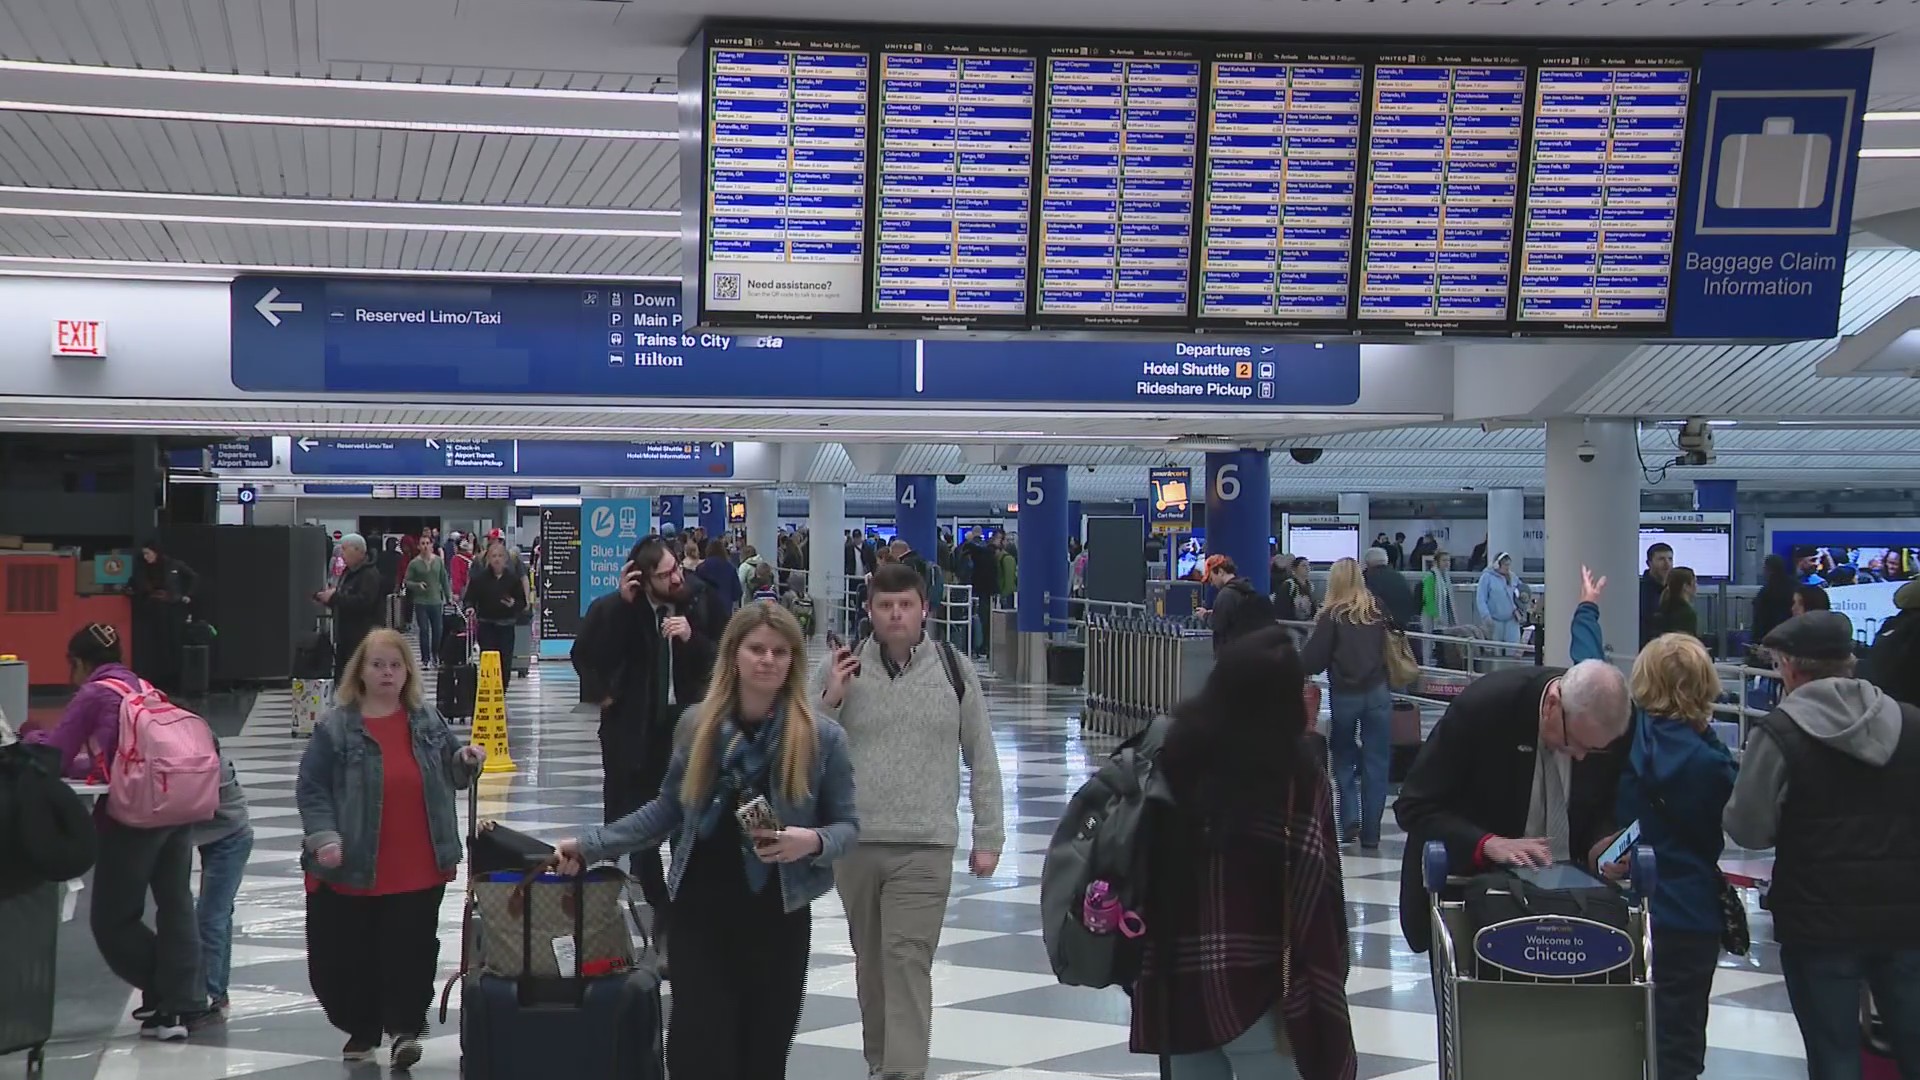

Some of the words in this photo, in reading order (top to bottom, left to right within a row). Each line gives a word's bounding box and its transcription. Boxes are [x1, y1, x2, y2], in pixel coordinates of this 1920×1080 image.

[1685, 252, 1773, 275] Baggage
[1780, 252, 1836, 271] Claim
[747, 280, 774, 289] Need
[775, 280, 832, 290] assistance?
[1703, 277, 1813, 295] Information
[634, 293, 675, 306] Down
[355, 309, 425, 323] Reserved
[430, 310, 501, 325] Limo/Taxi
[634, 314, 670, 326] Main
[57, 320, 99, 347] EXIT
[634, 333, 677, 347] Trains
[681, 334, 695, 347] to
[700, 335, 730, 350] City
[756, 336, 783, 348] cta
[1176, 342, 1251, 358] Departures
[634, 352, 683, 366] Hilton
[1144, 362, 1178, 376] Hotel
[1182, 362, 1230, 376] Shuttle
[1238, 364, 1249, 376] 2
[1137, 382, 1203, 395] Rideshare
[1207, 383, 1252, 399] Pickup
[219, 443, 249, 451] Ticketing
[1216, 463, 1241, 501] 6
[900, 484, 916, 508] 4
[1025, 476, 1044, 506] 5
[662, 501, 672, 516] 2
[701, 498, 712, 514] 3
[591, 545, 613, 557] Blue
[591, 560, 618, 572] trains
[591, 576, 600, 586] to
[603, 576, 620, 589] city
[1526, 935, 1571, 945] Welcome
[1573, 937, 1583, 945] to
[1524, 946, 1586, 964] Chicago
